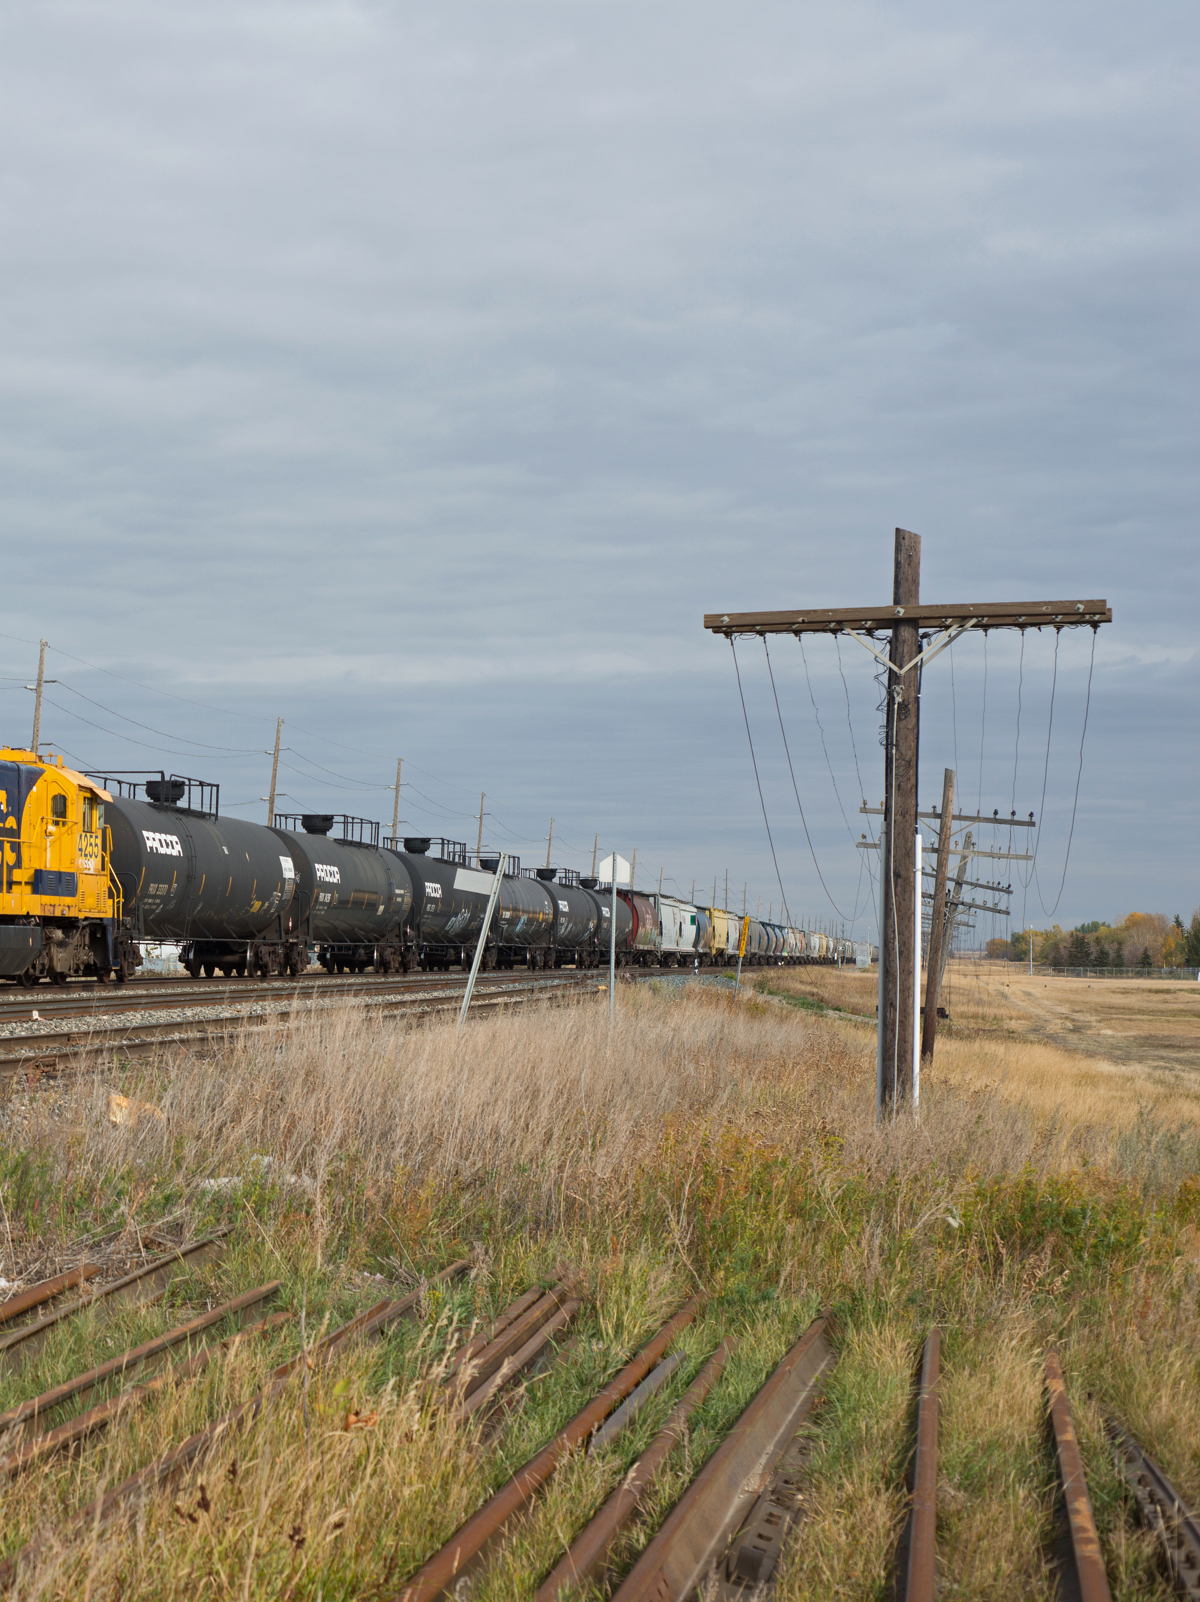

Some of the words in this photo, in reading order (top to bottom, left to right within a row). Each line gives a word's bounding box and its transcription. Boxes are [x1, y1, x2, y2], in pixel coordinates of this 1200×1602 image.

[77, 833, 100, 859] 4255
[141, 829, 184, 857] PROCOR
[314, 863, 341, 884] PROCOR
